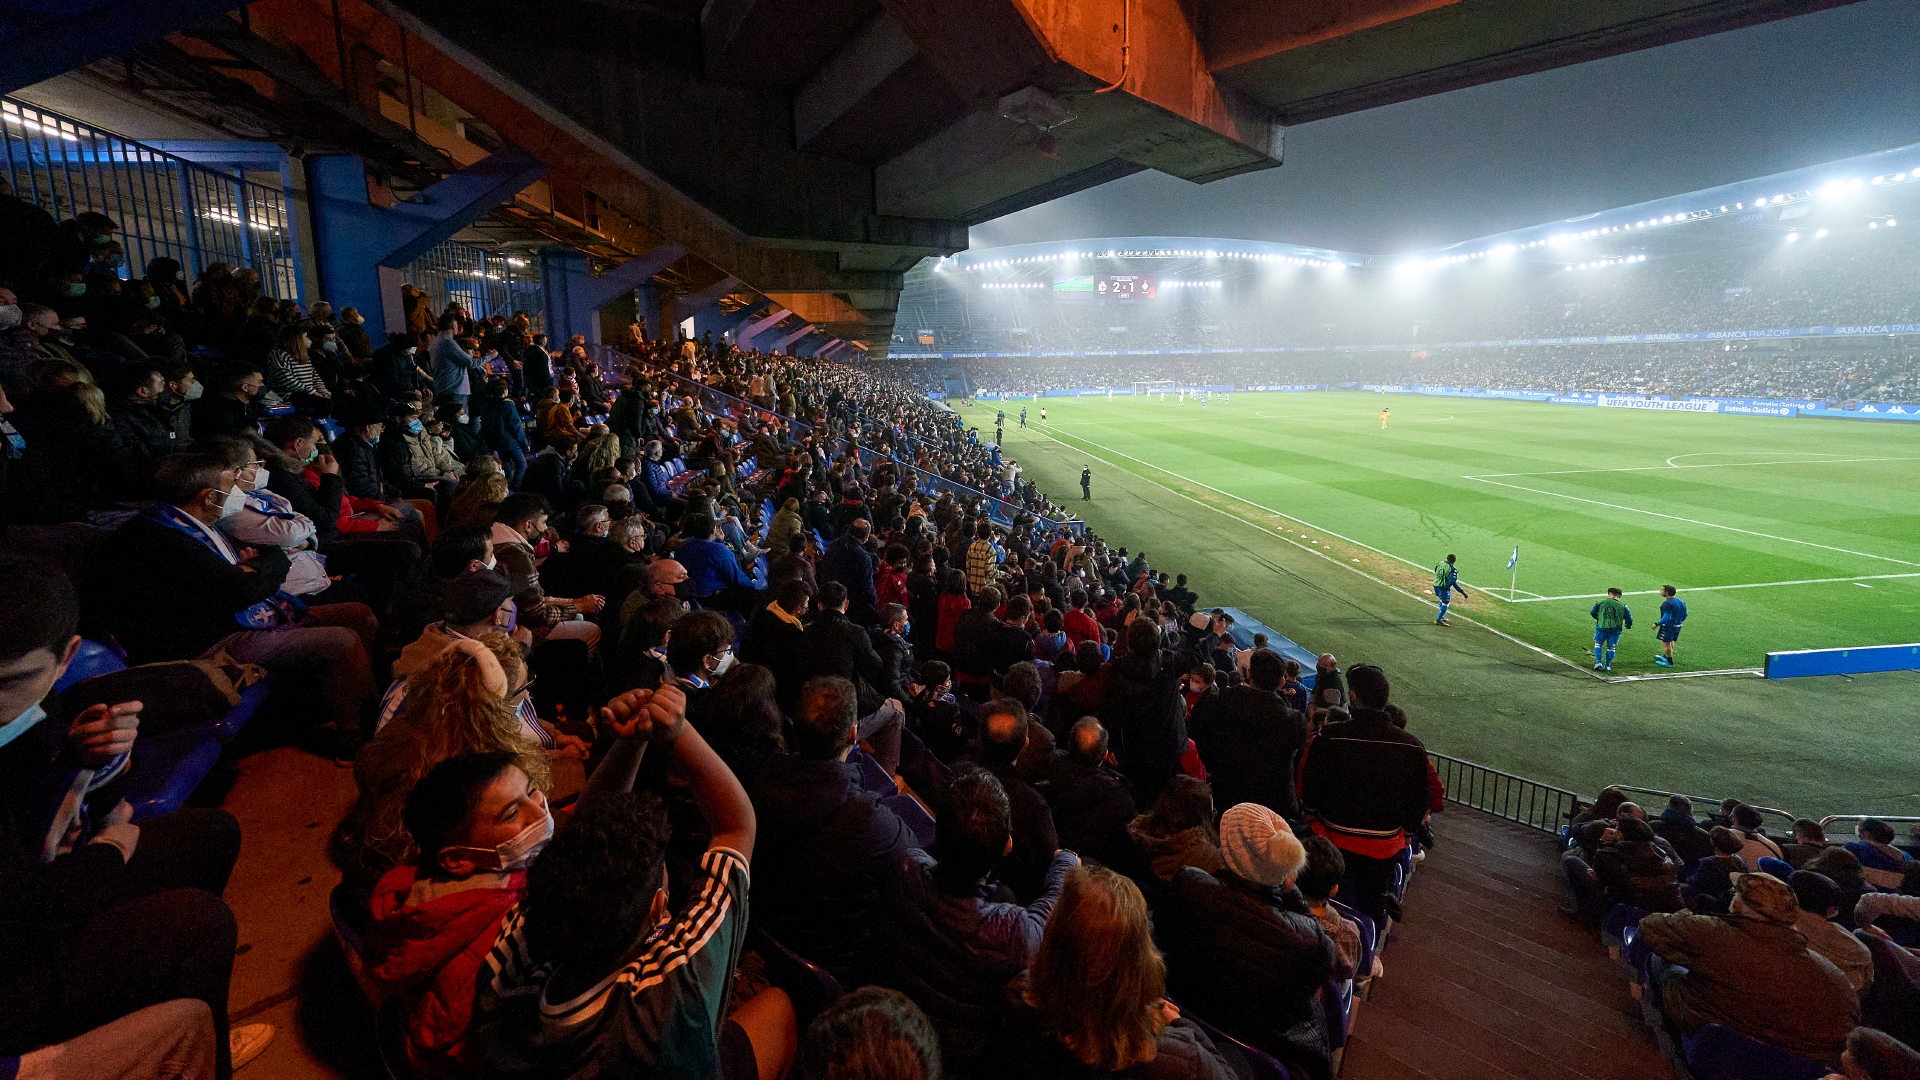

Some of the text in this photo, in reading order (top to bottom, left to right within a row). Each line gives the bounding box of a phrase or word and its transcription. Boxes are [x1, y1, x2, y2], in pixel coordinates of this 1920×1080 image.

[1740, 214, 1763, 223] UEFA
[1113, 282, 1134, 292] 2 1
[1707, 329, 1790, 339] ABANCA RIAZOR
[1834, 325, 1889, 335] ABANCA
[1645, 333, 1681, 341] ABANCA
[1607, 399, 1707, 411] UEFA YOUTH LEAGUE
[1725, 405, 1779, 415] Estrella Galicia
